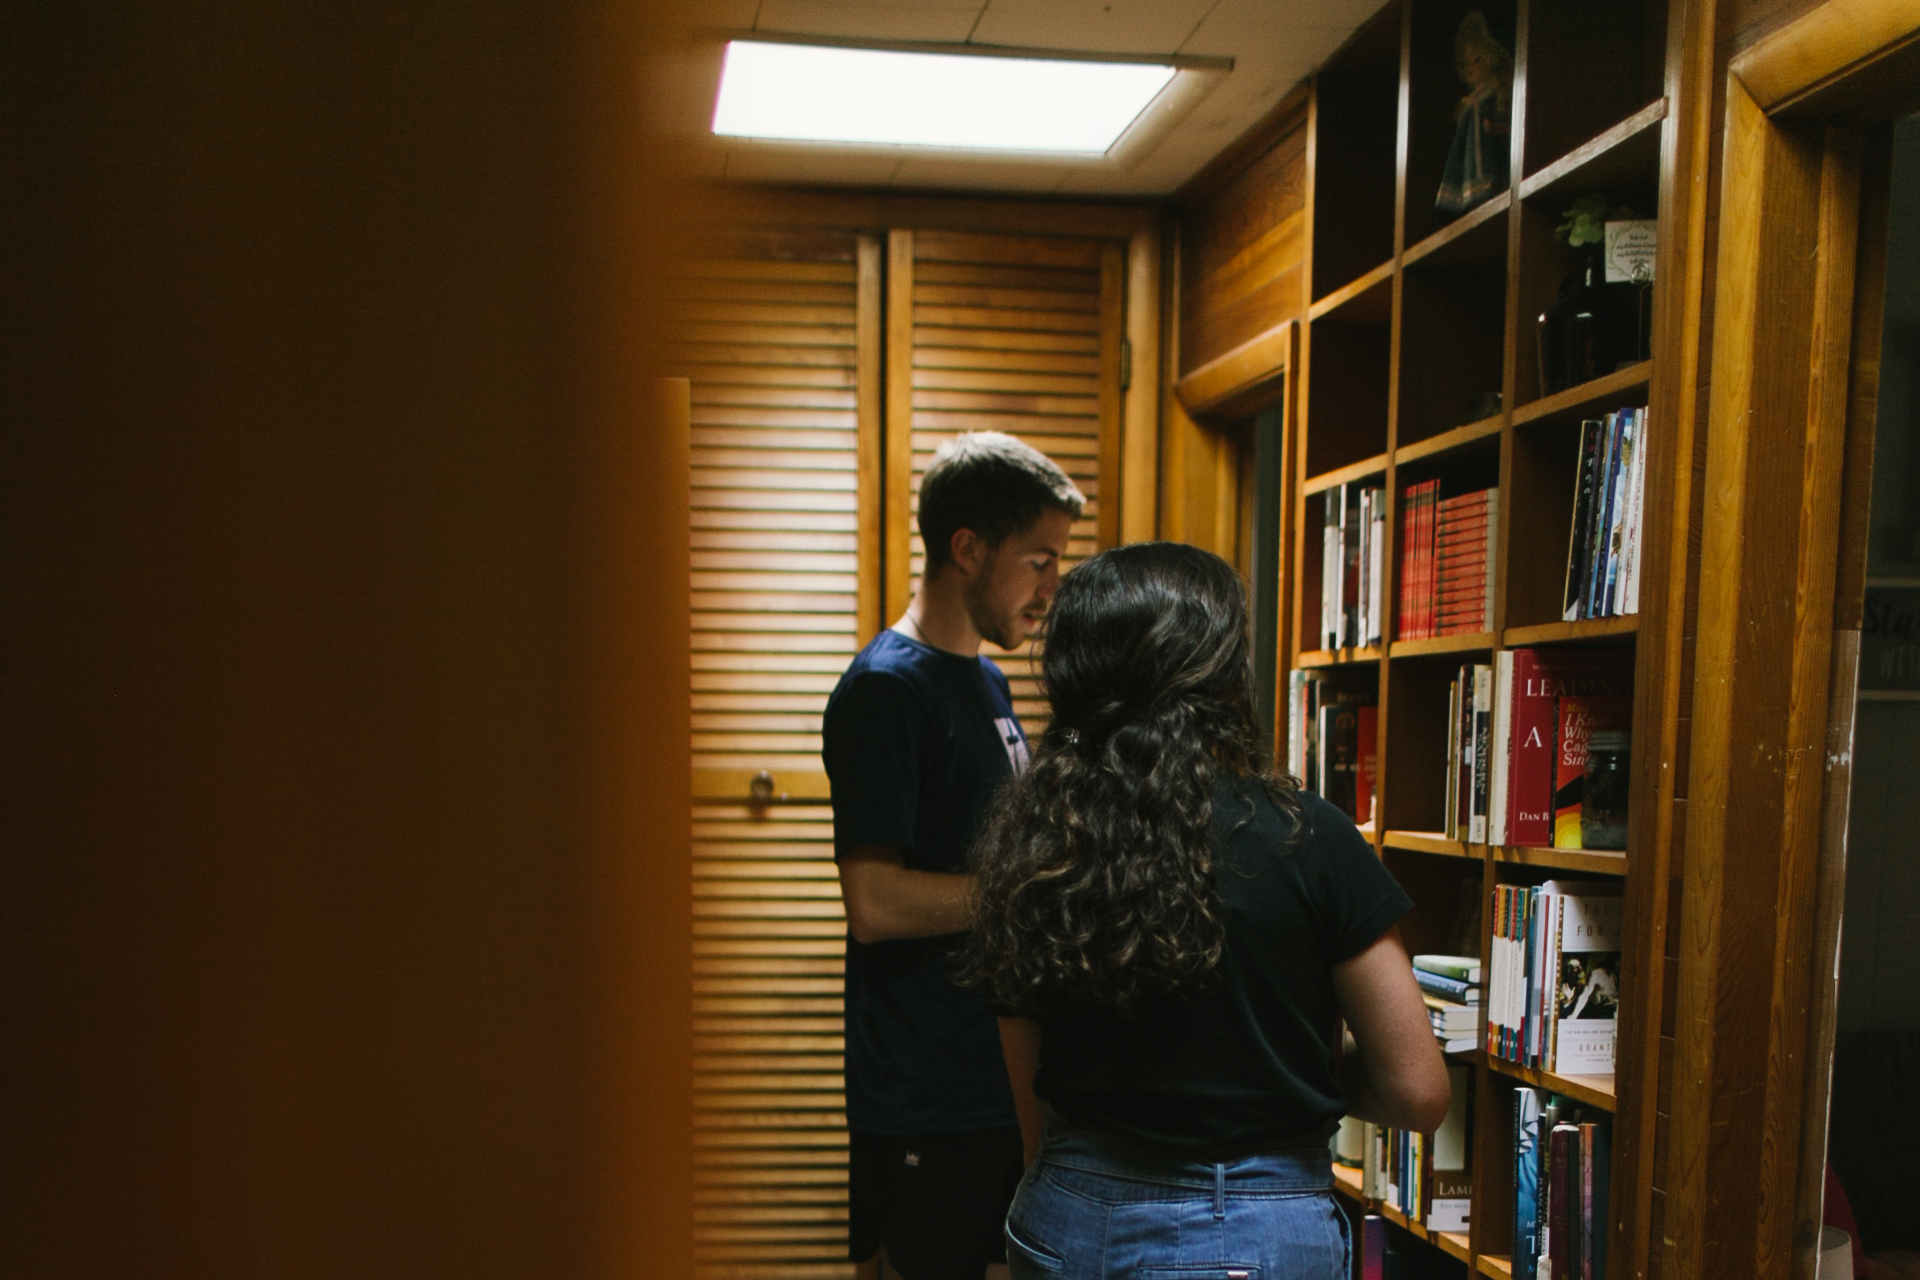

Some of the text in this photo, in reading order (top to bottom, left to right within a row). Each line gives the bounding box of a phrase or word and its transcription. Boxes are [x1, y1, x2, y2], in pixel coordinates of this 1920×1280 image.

[1523, 726, 1543, 748] A
[1519, 811, 1541, 821] DAN
[1583, 903, 1609, 916] THE
[1577, 925, 1603, 937] FOR
[1579, 1043, 1611, 1052] BRANT
[1526, 1220, 1537, 1230] M
